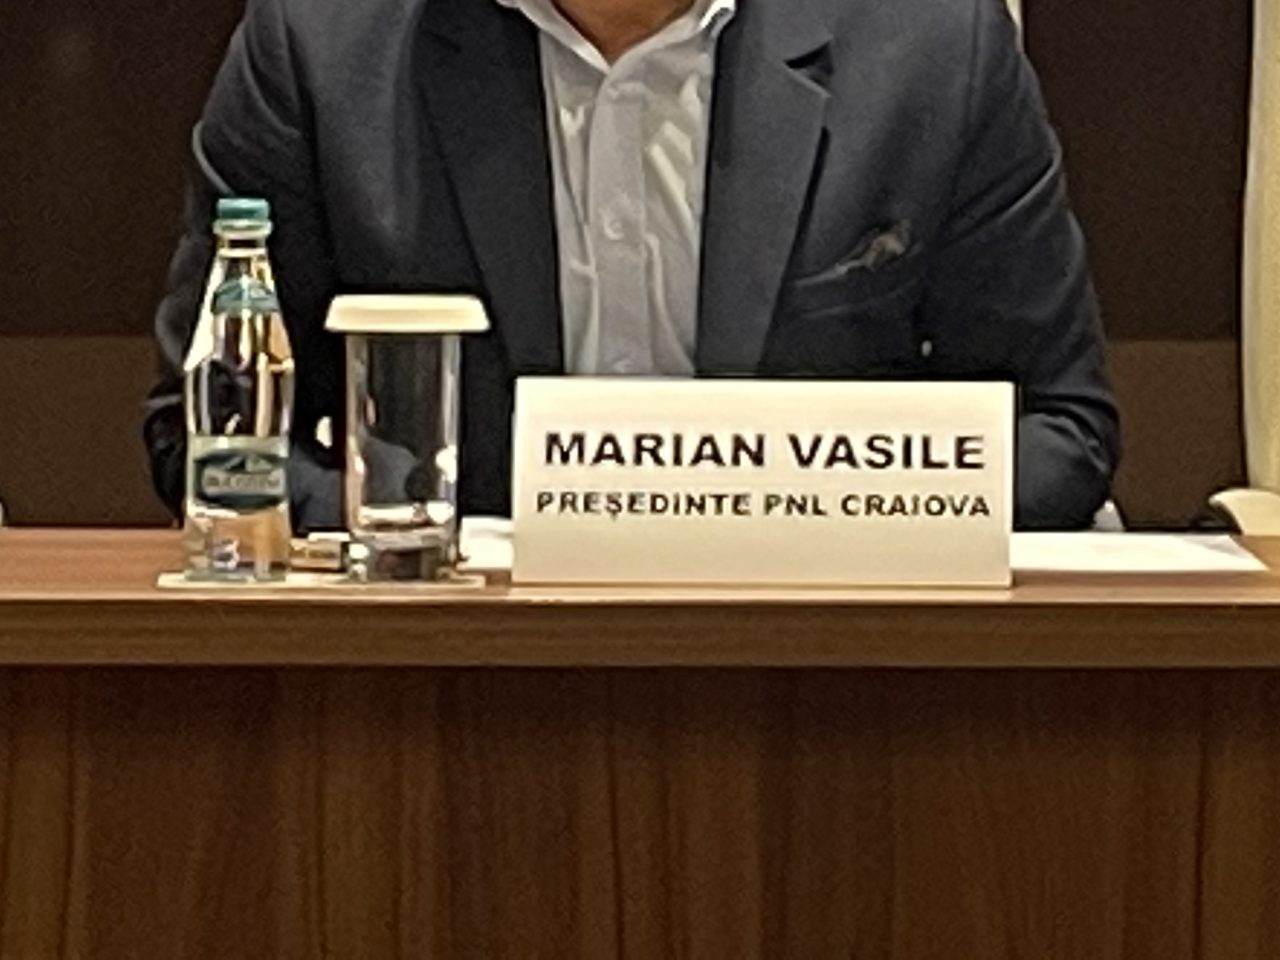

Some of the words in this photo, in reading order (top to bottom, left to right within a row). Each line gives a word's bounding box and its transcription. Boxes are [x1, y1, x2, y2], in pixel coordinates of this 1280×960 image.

[545, 431, 766, 468] MARIAN
[788, 433, 985, 470] VASILE
[763, 493, 828, 517] PNL
[840, 494, 990, 517] CRAIOVA
